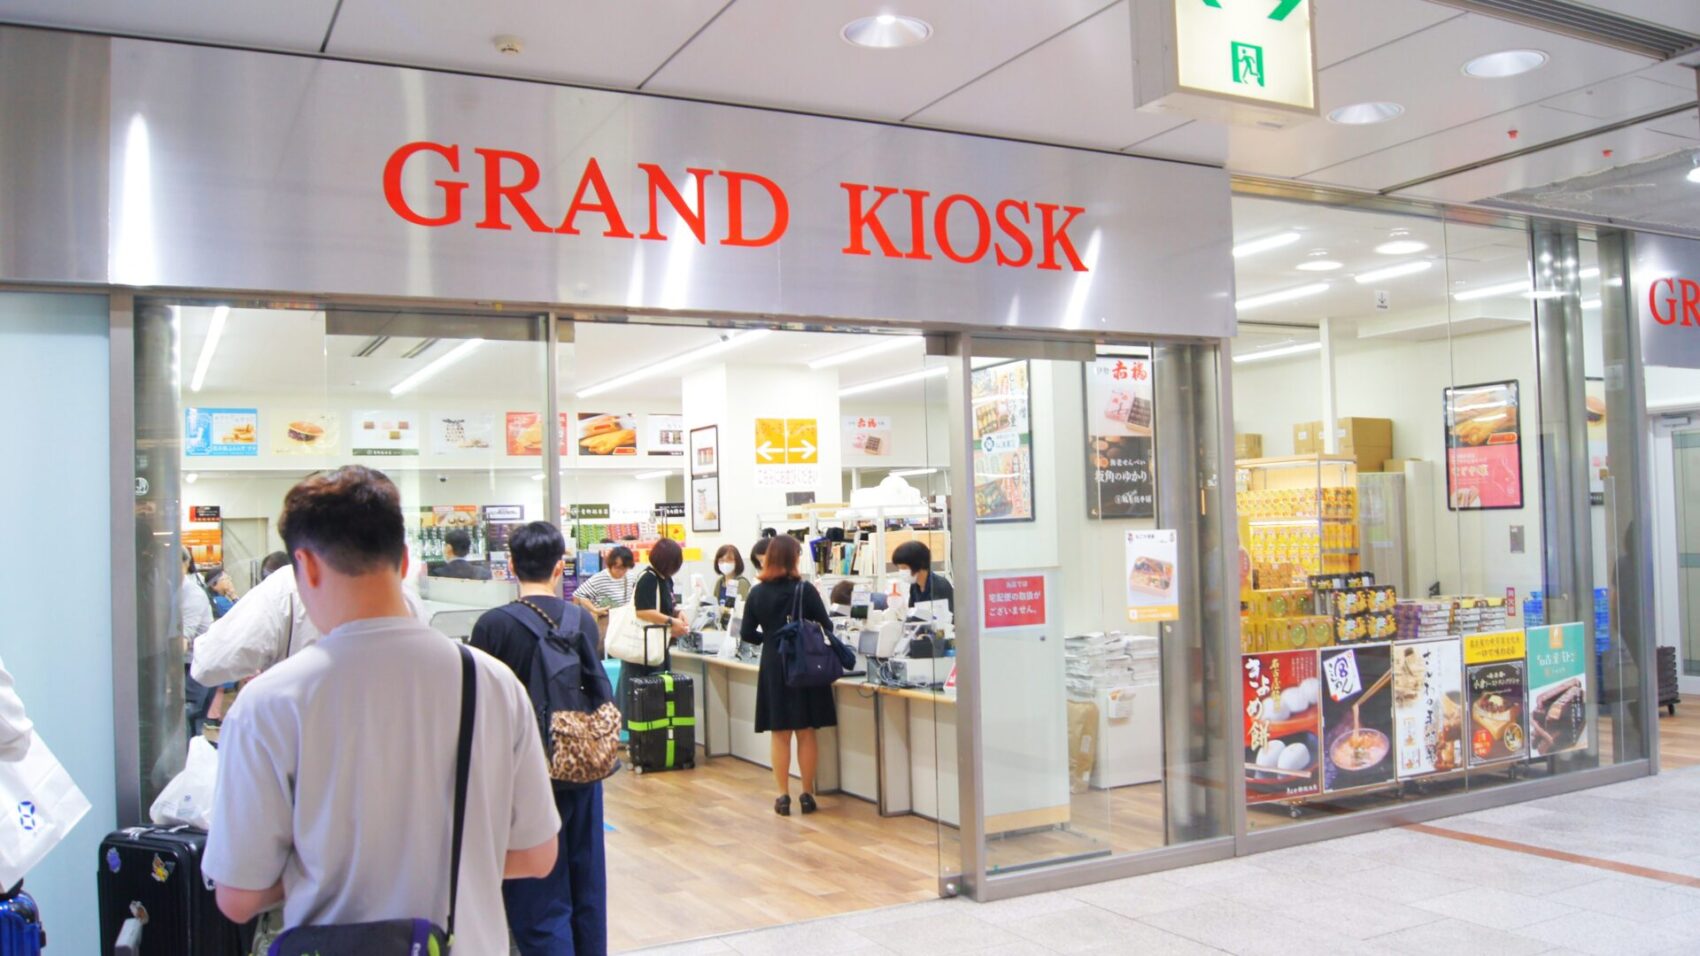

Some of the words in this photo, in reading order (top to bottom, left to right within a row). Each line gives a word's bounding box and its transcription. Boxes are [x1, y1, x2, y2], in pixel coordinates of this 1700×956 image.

[383, 142, 790, 248] GRAND
[840, 182, 1090, 272] KIOSK
[1112, 360, 1147, 380] 赤福
[989, 605, 1037, 617] ございません。
[1245, 657, 1271, 755] きよめ餅
